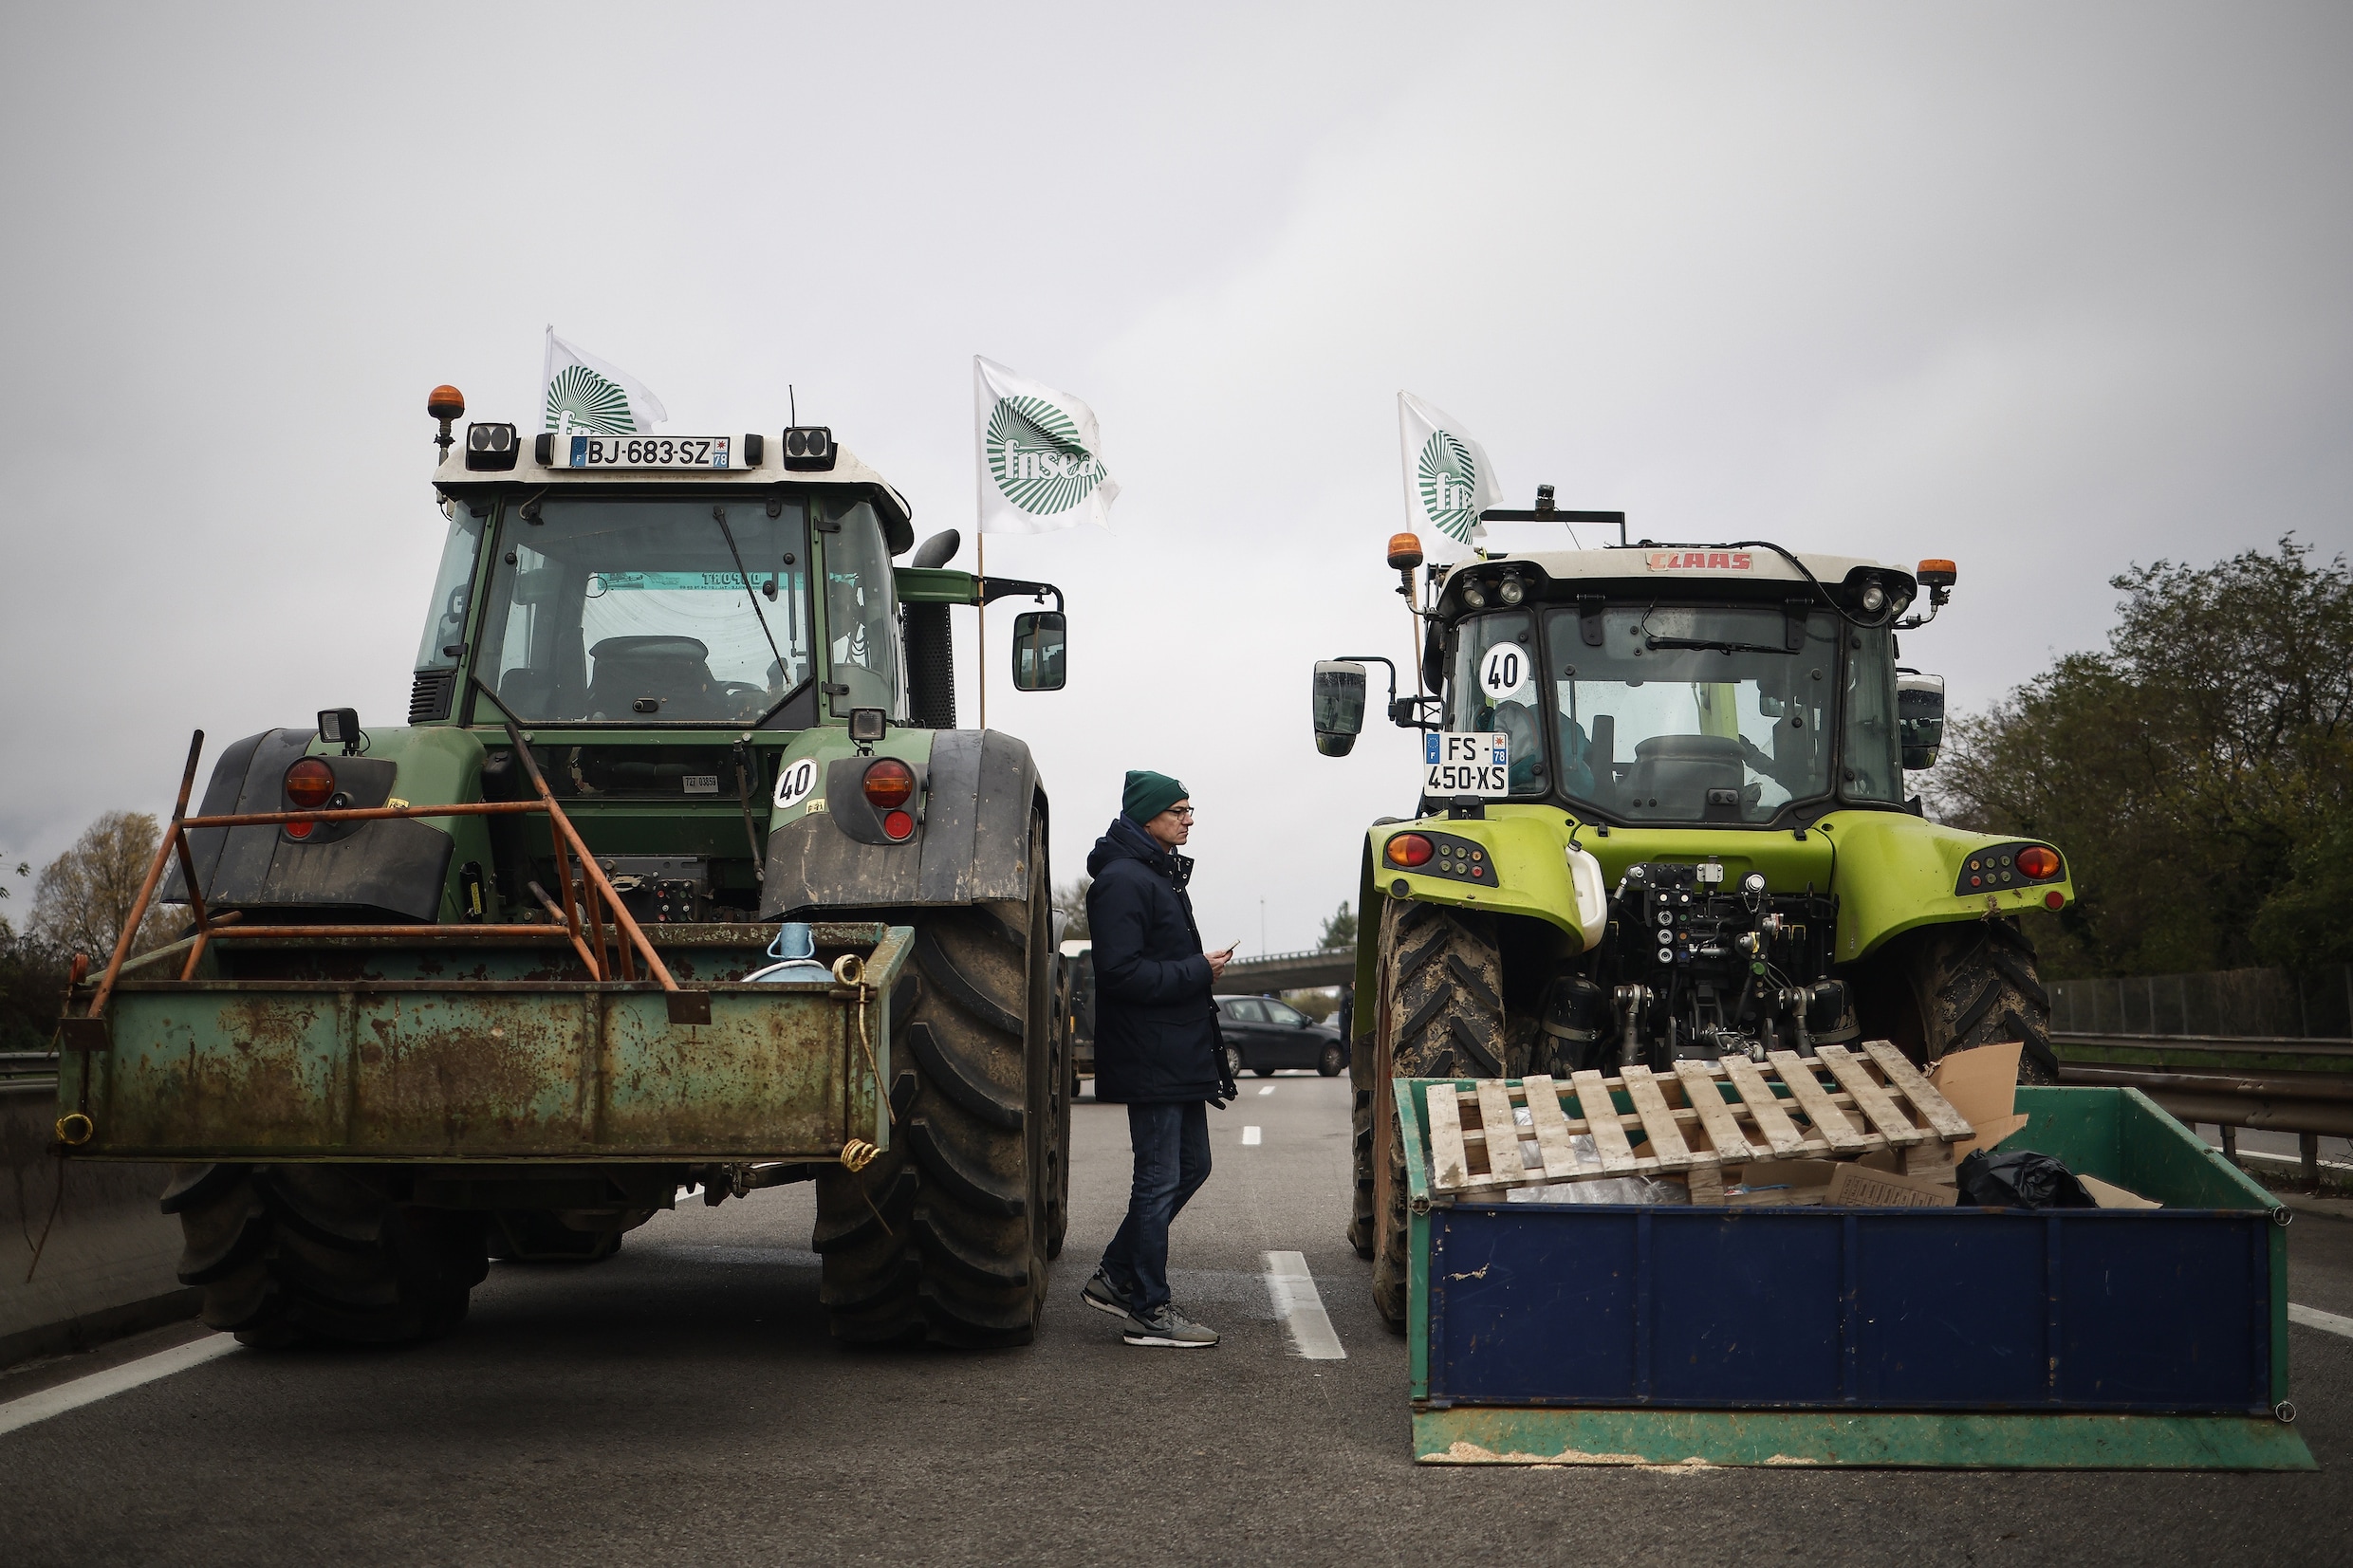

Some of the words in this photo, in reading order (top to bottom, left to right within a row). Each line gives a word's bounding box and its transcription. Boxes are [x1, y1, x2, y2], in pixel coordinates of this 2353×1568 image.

[588, 440, 711, 464] BJ-683-SZ
[713, 453, 728, 466] 78
[1001, 438, 1098, 480] fnsea
[1651, 553, 1751, 569] CLAAS
[1488, 653, 1518, 690] 40
[1448, 737, 1476, 761] FS
[1494, 750, 1506, 761] 78
[779, 764, 810, 800] 40
[1428, 766, 1505, 789] 450-XS
